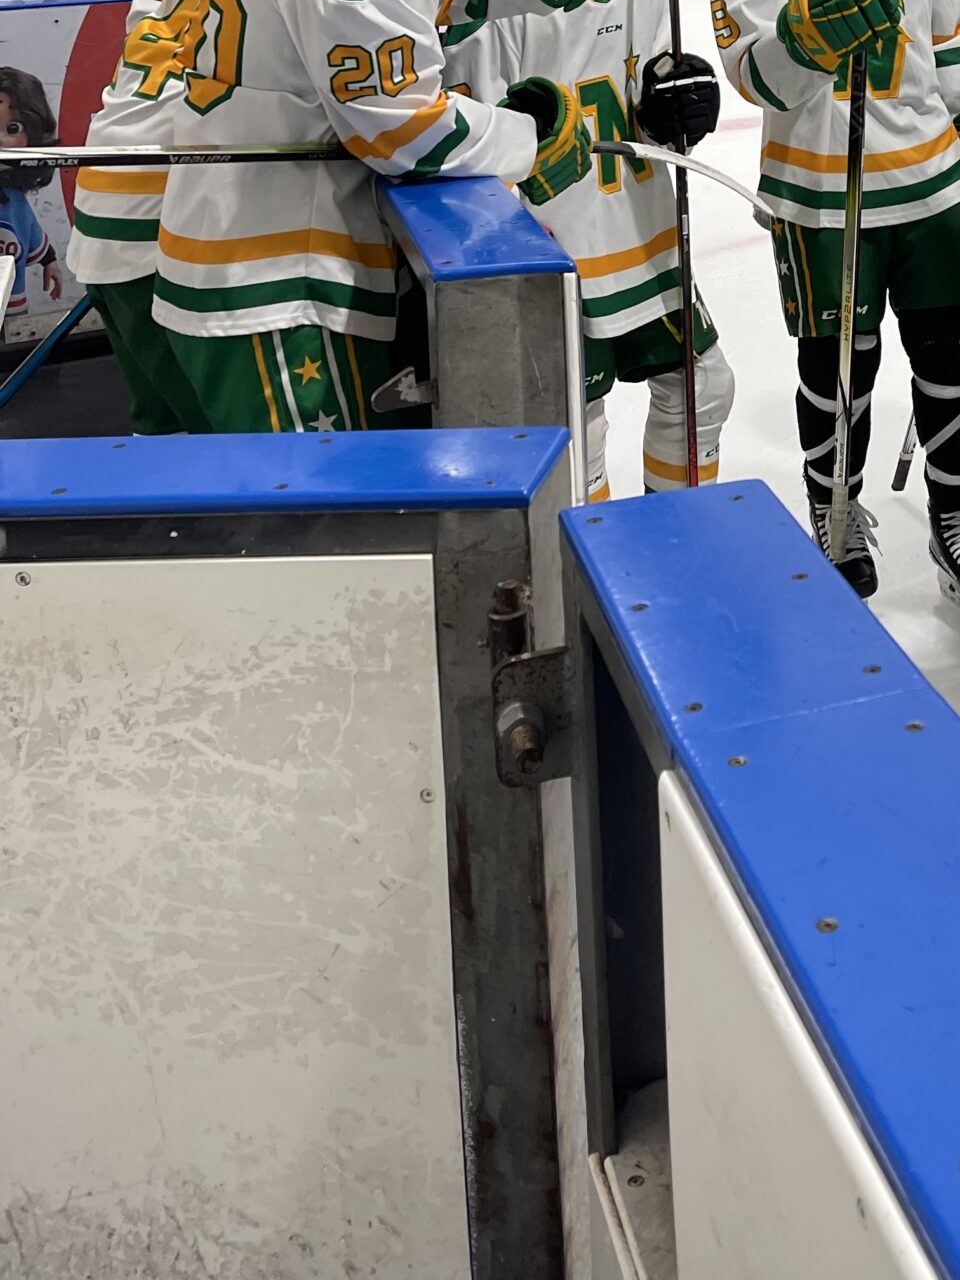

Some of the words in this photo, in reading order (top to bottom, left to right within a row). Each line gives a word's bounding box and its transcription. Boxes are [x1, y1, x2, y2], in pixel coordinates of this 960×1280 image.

[597, 24, 623, 36] CCM
[327, 34, 419, 104] 20
[179, 154, 232, 163] BAUER
[822, 305, 868, 320] CM
